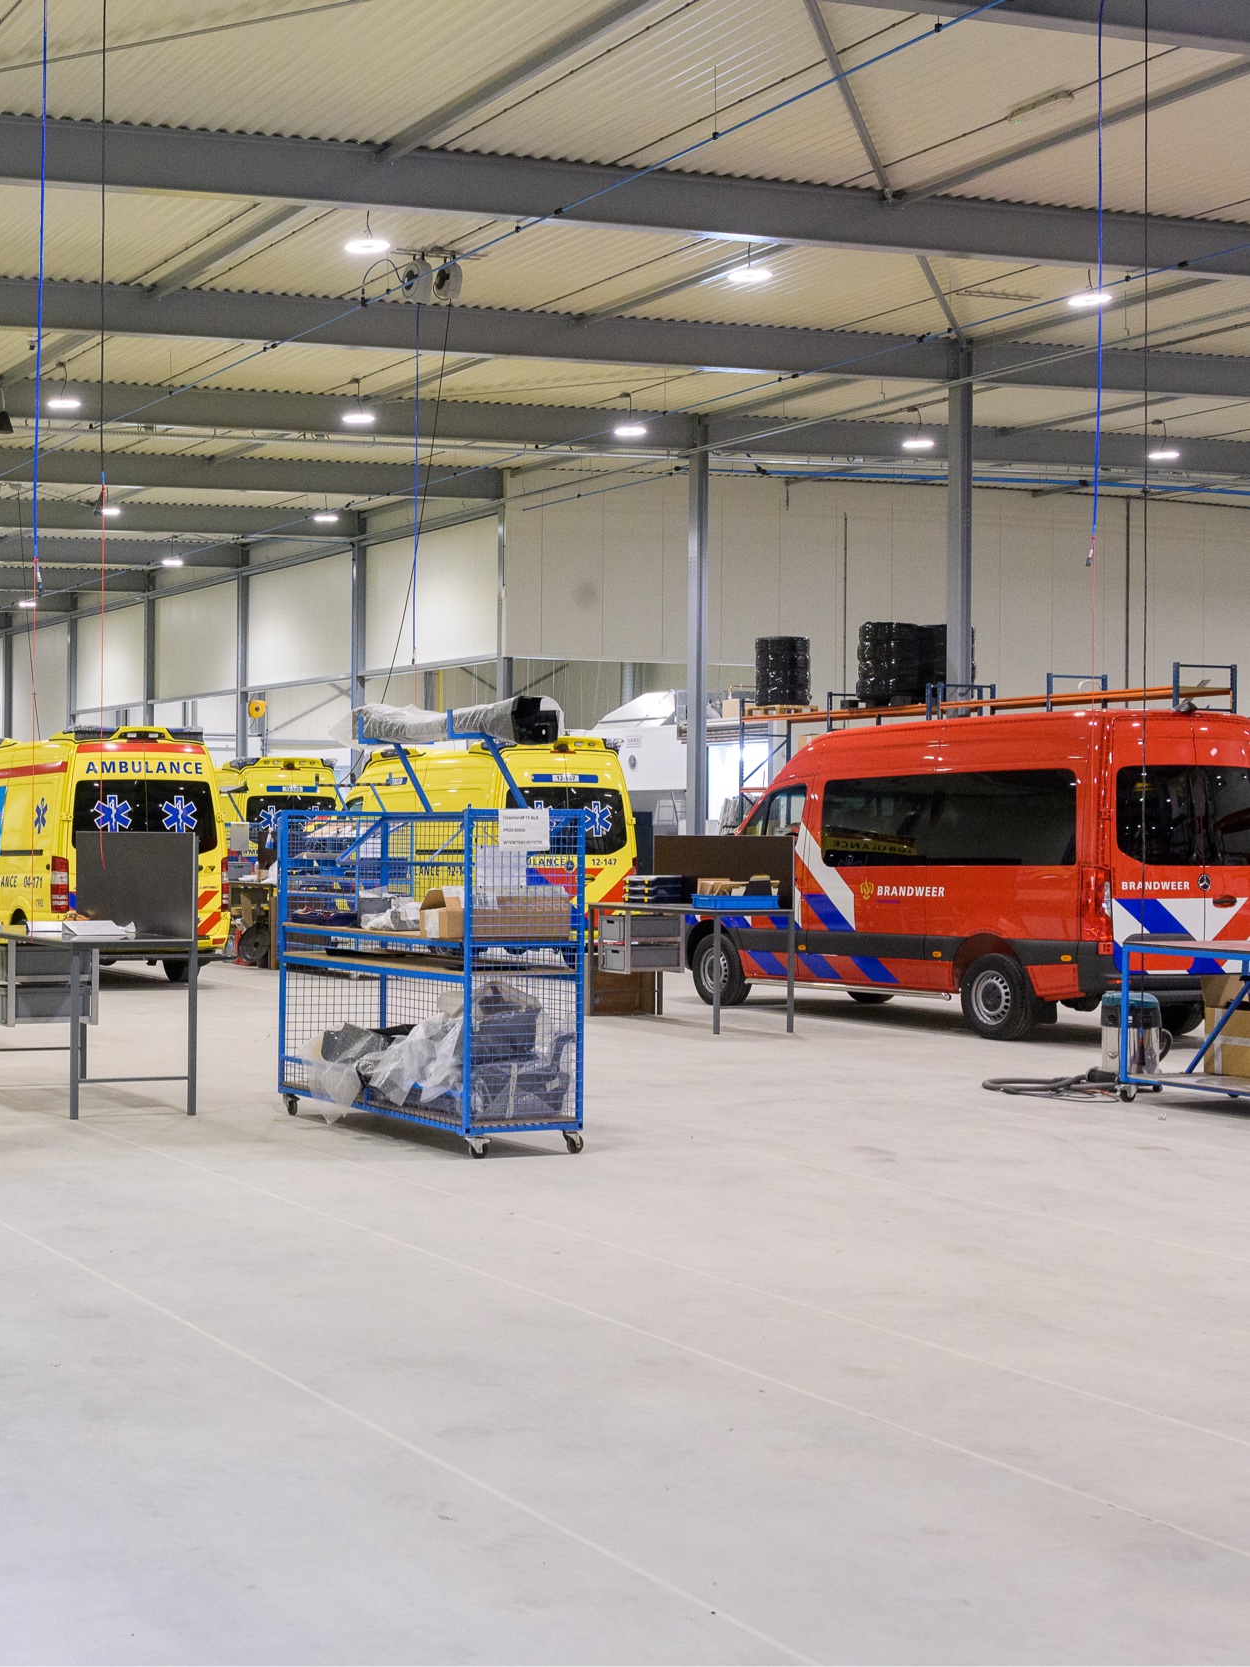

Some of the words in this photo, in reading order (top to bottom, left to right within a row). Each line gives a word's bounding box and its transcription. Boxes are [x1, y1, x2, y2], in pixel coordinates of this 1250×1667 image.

[85, 761, 203, 775] AMBULANCE
[591, 858, 617, 866] 12-147
[877, 885, 945, 897] BRANDWEER
[1121, 881, 1190, 891] BRANDWEER
